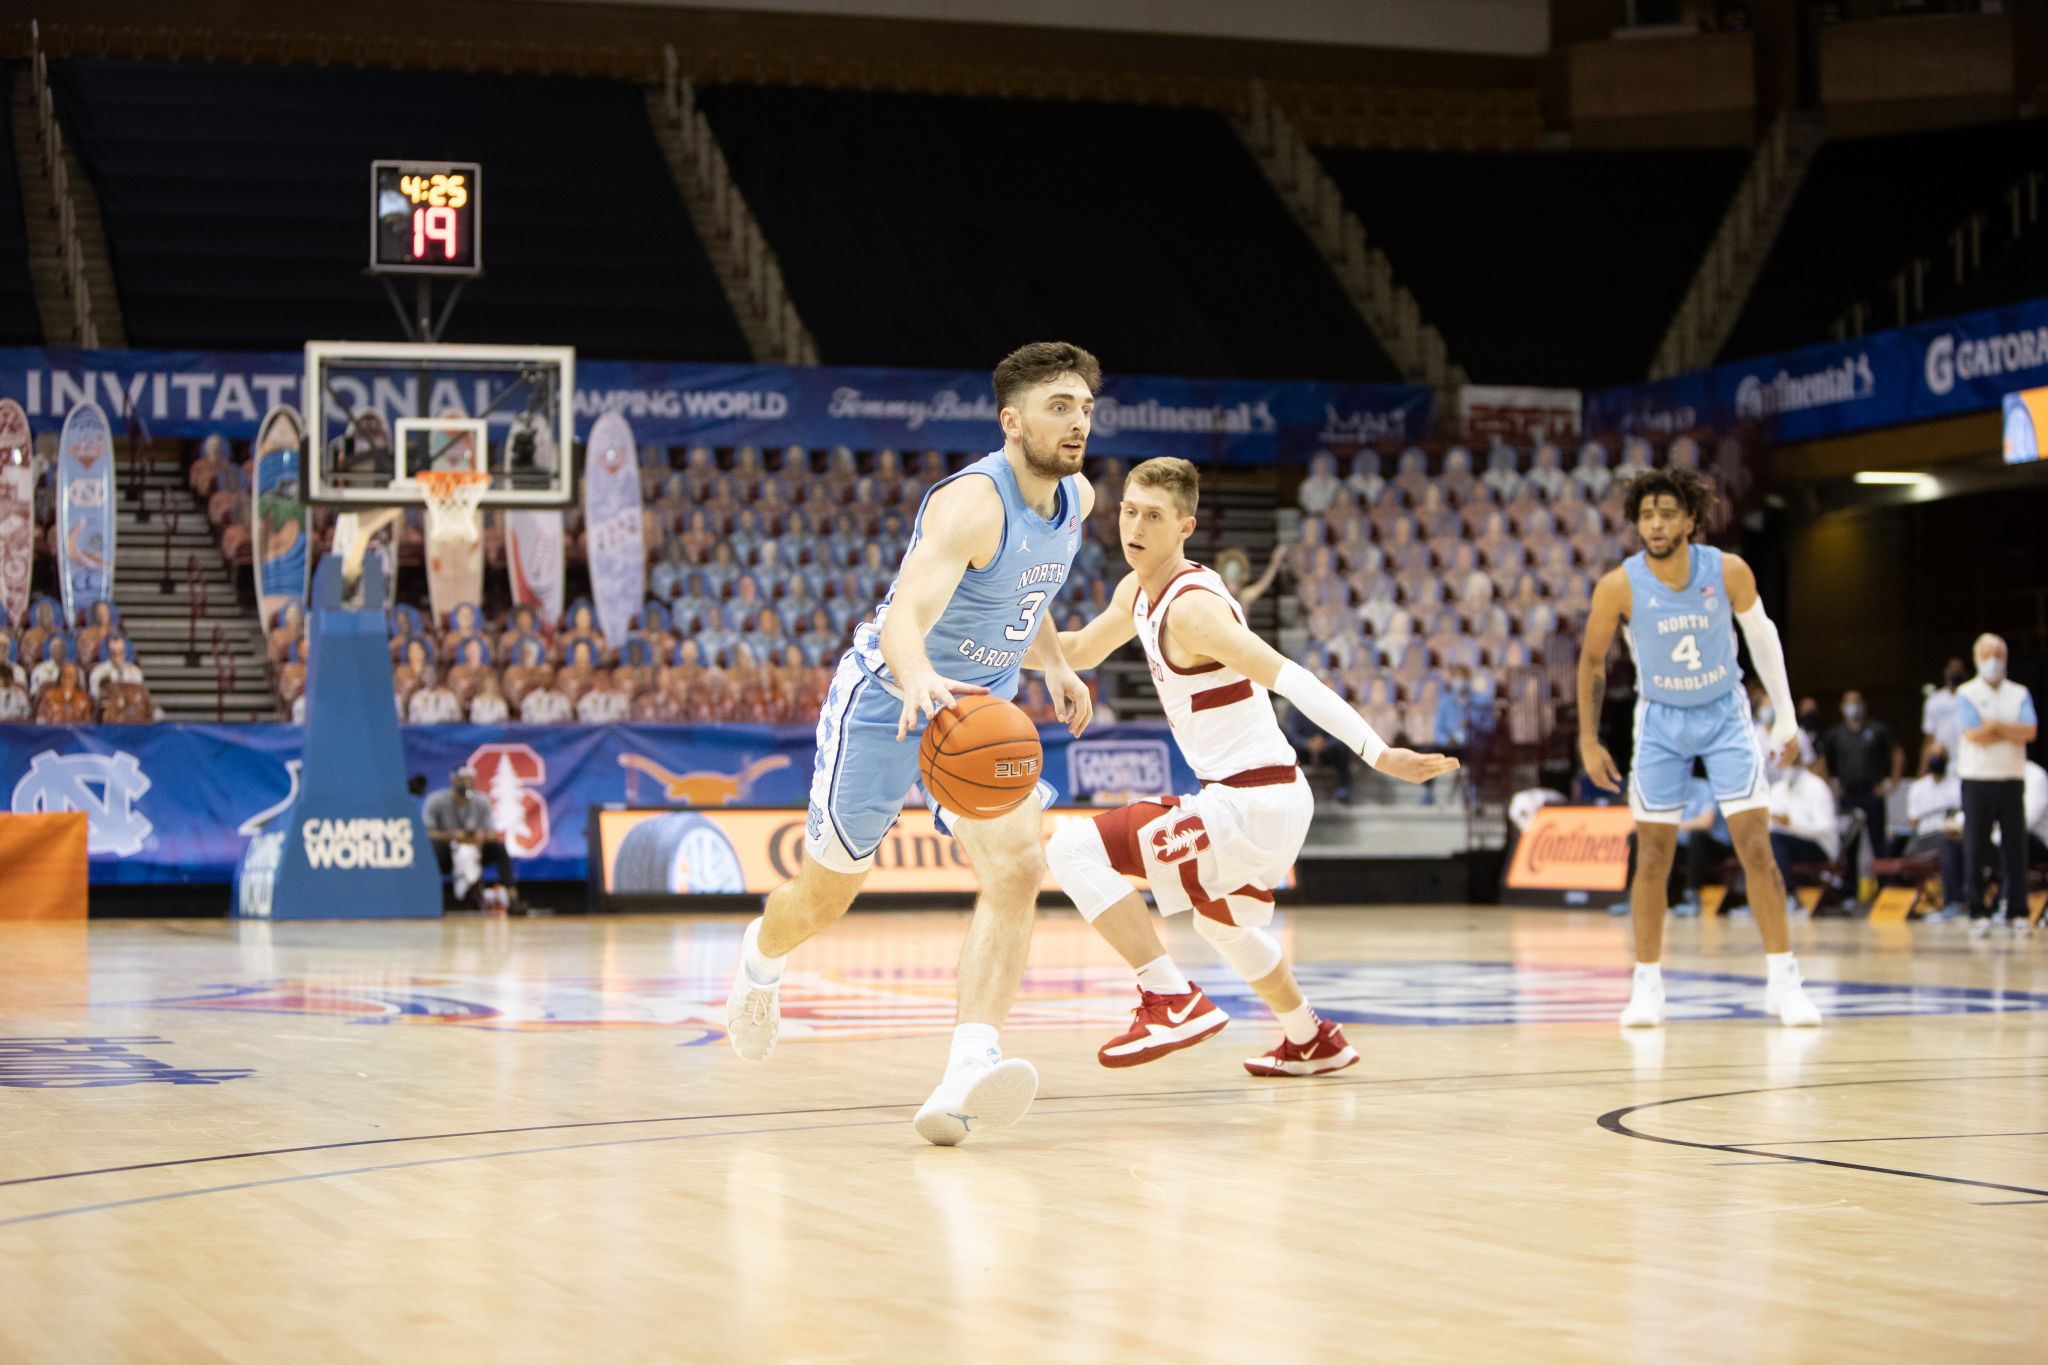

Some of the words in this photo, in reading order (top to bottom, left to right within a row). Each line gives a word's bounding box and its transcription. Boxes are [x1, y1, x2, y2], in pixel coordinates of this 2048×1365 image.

[400, 174, 467, 208] 4:25
[413, 206, 456, 259] 19
[26, 369, 516, 422] INVITATONAL
[560, 388, 682, 419] AMPING
[683, 389, 788, 420] WORLD
[1015, 563, 1065, 592] NORTH
[1004, 590, 1047, 641] 3
[1657, 613, 1709, 635] NORTH
[1671, 634, 1702, 671] 4
[1652, 664, 1727, 691] CAROLINA
[994, 757, 1039, 778] ELITE
[302, 817, 413, 842] CAMPING
[305, 841, 415, 869] WORLD
